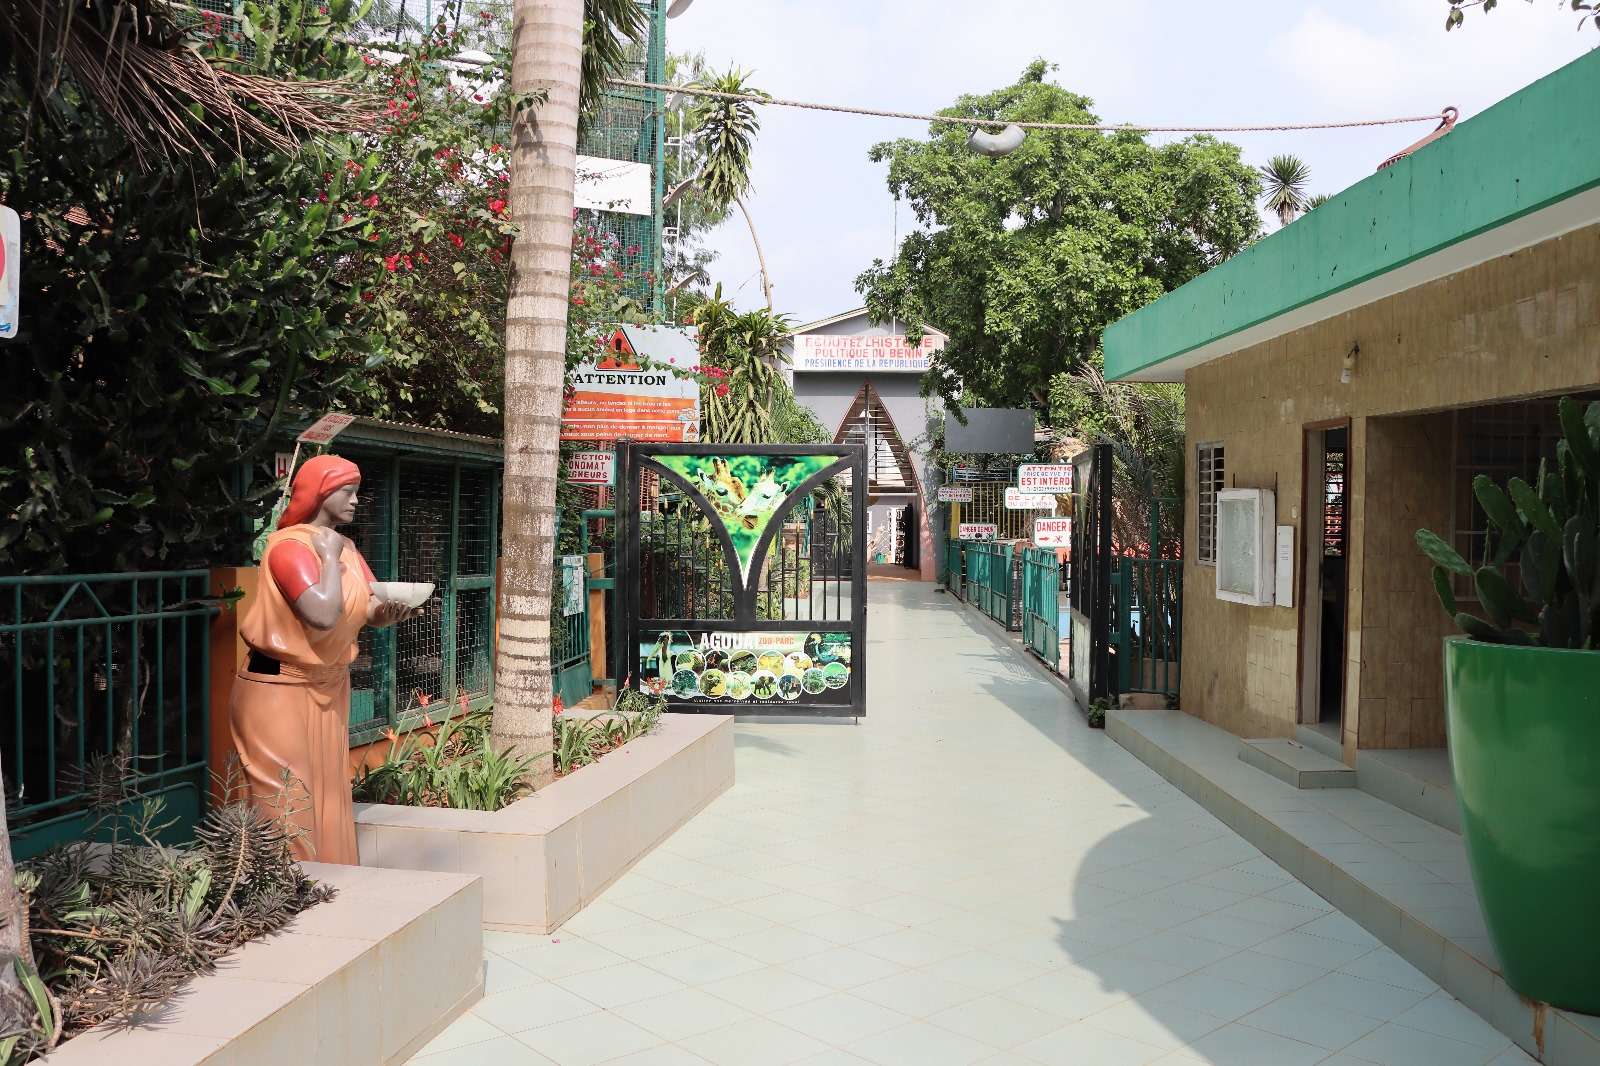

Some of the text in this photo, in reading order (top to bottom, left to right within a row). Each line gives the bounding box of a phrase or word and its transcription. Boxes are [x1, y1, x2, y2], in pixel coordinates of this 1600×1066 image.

[889, 348, 923, 358] BENIN
[879, 359, 929, 368] REPUBLIQUE
[574, 373, 667, 386] ATTENTION
[1021, 478, 1037, 486] EST
[1036, 521, 1067, 532] DANGER
[758, 637, 794, 645] ZOO-PARC
